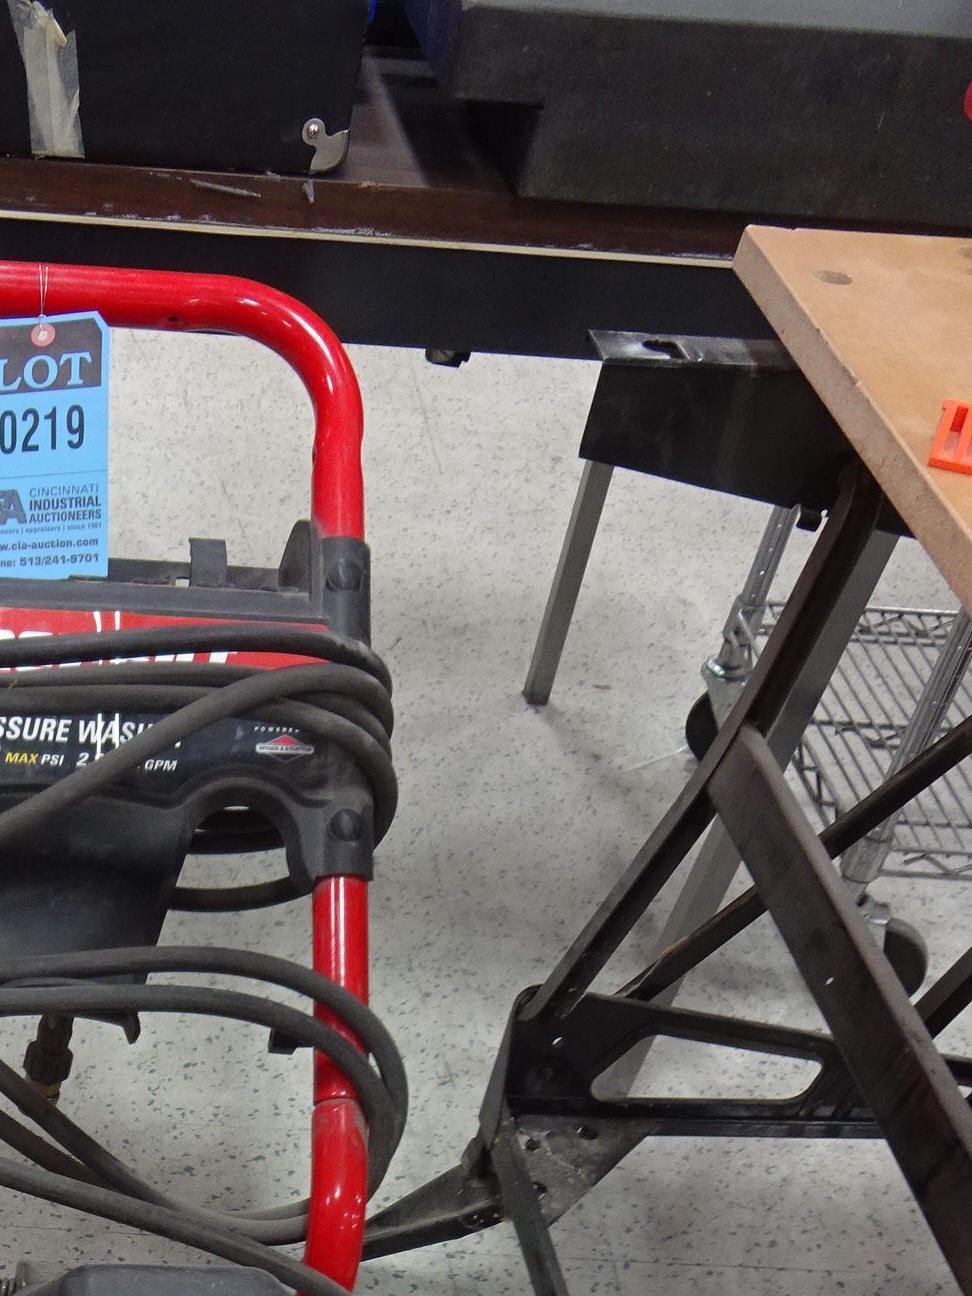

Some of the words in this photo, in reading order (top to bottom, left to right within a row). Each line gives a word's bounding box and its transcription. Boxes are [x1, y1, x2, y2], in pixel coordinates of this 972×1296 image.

[29, 484, 99, 498] CINCINNATI
[29, 496, 102, 511] INDUSTRIAL
[29, 509, 102, 524] AUCTIONEERS
[19, 553, 99, 566] 513/241-9701
[5, 752, 39, 765] MAX
[40, 753, 65, 766] PSI
[144, 758, 178, 772] GPM
